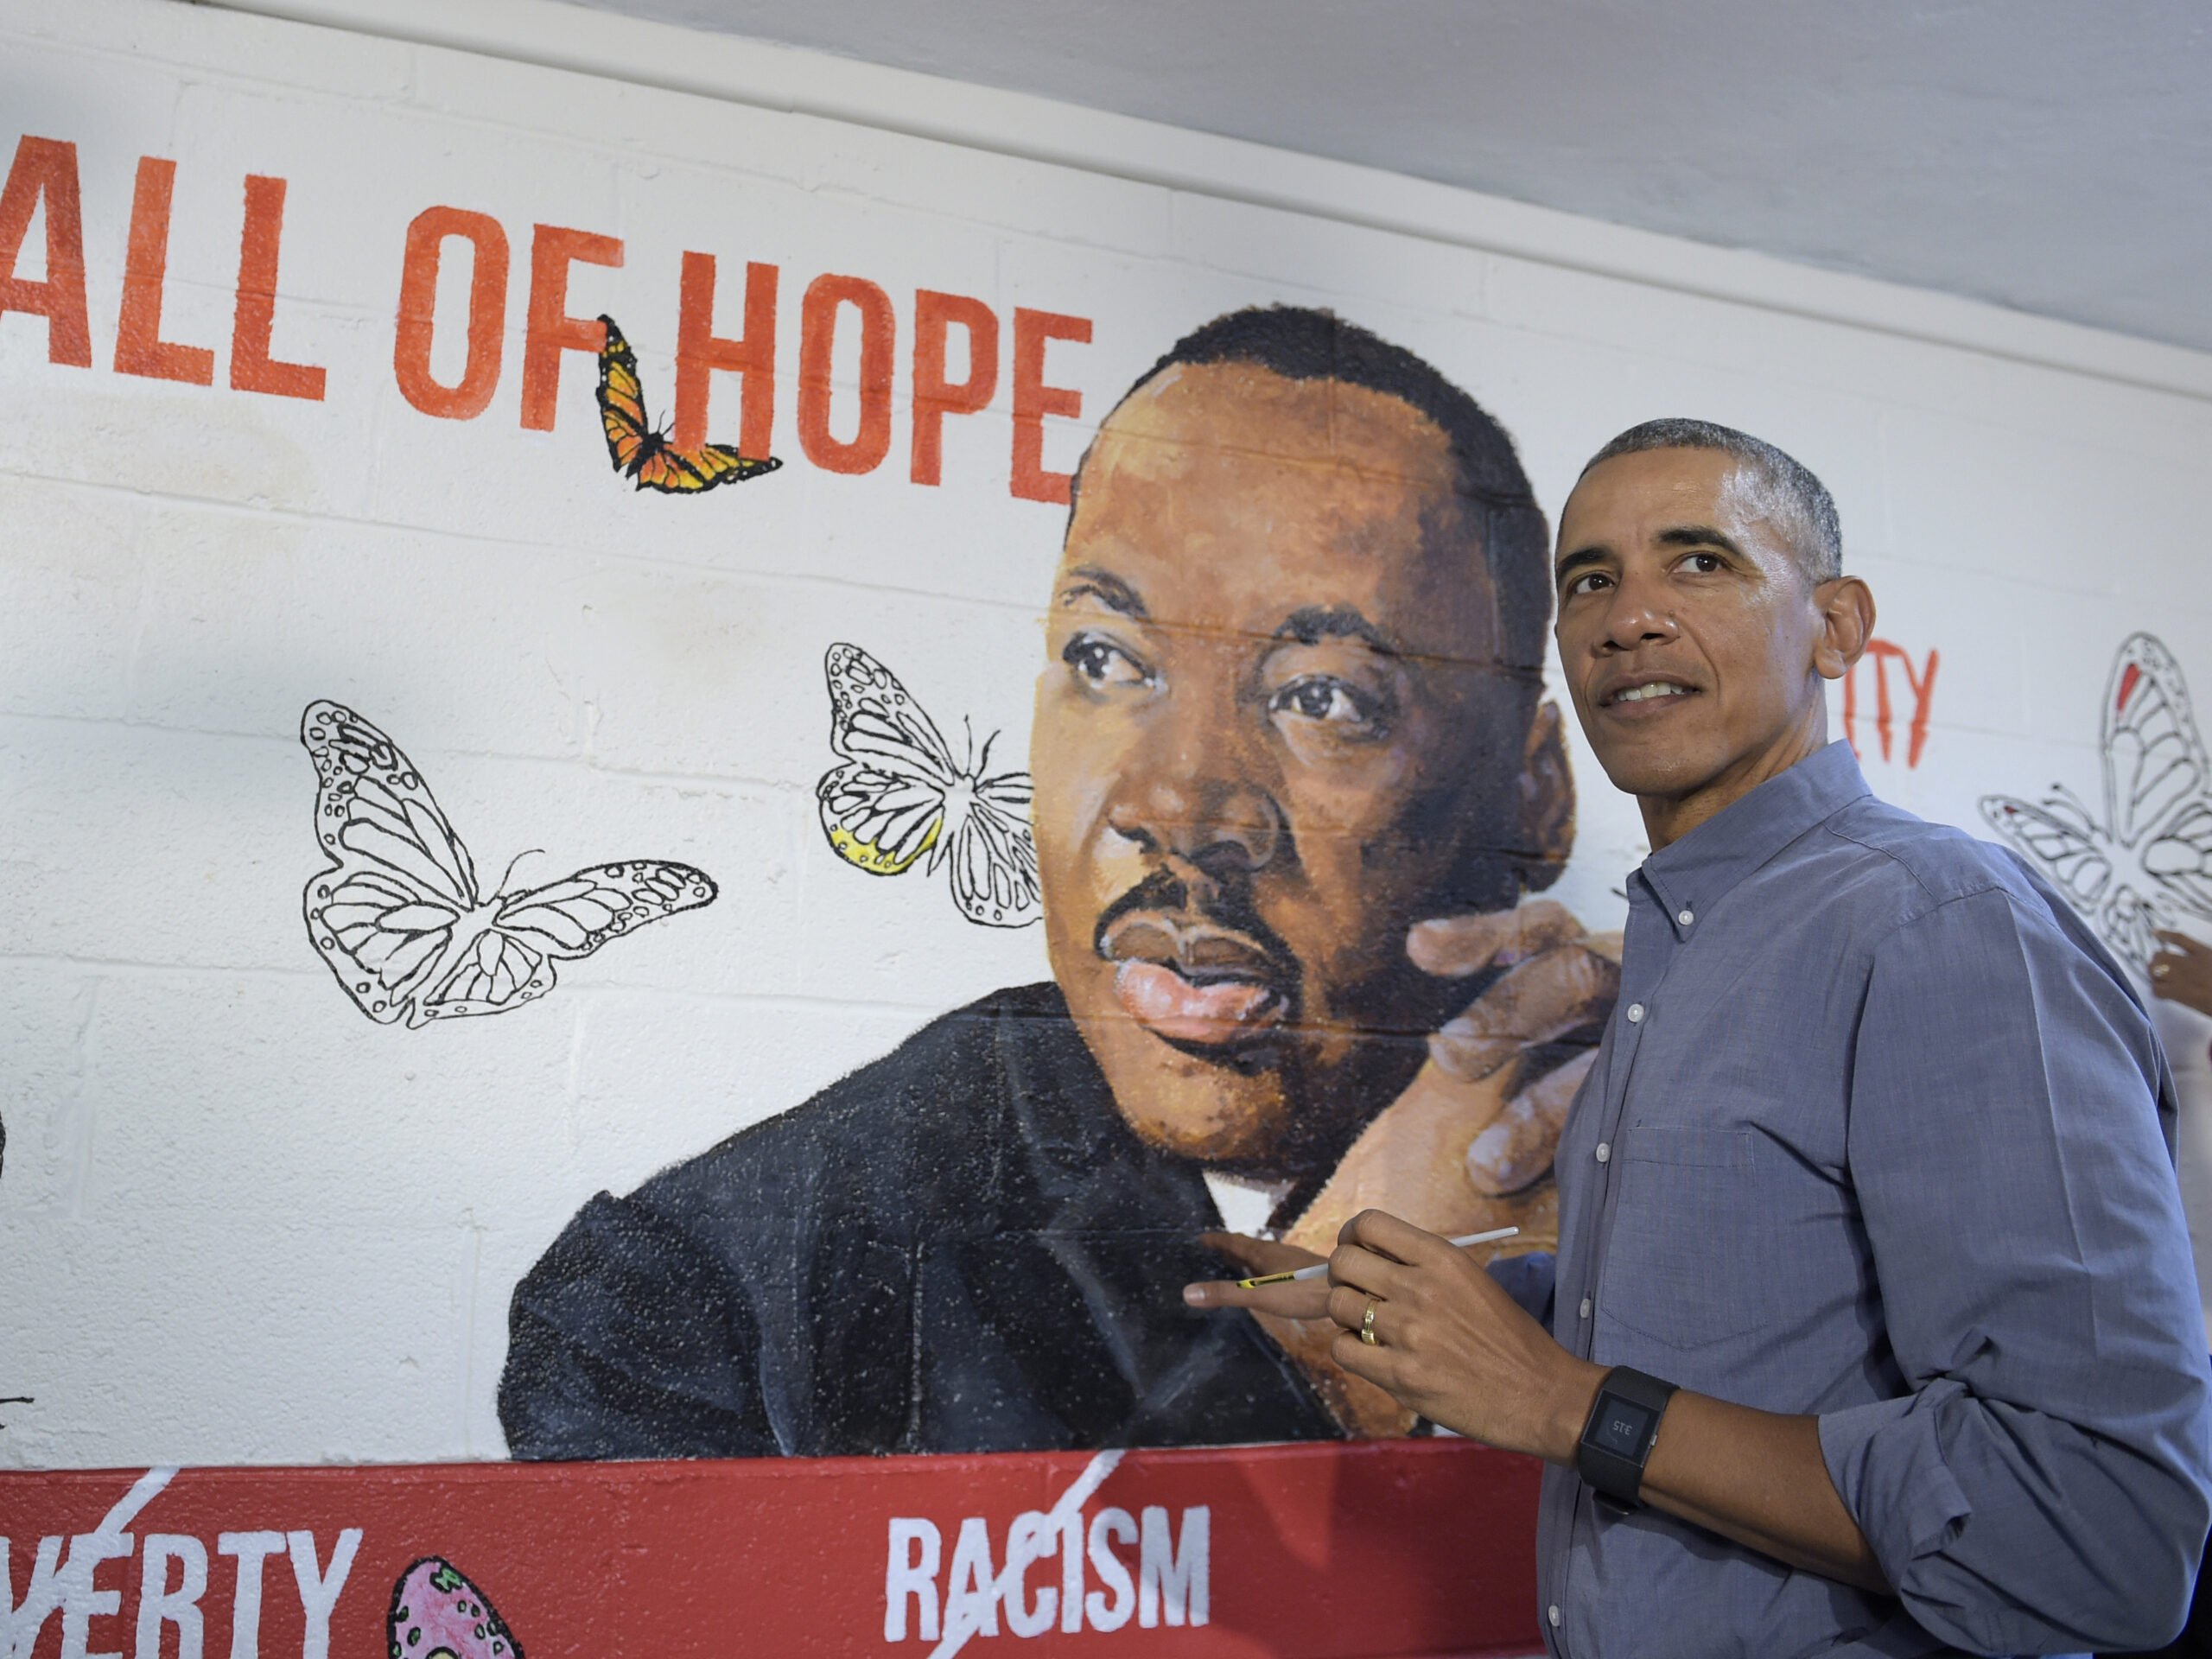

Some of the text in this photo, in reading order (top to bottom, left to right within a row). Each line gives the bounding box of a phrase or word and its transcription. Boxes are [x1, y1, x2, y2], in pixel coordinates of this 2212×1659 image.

[0, 134, 1092, 505] ALL OF HOPE
[884, 1505, 1210, 1642] RACISM
